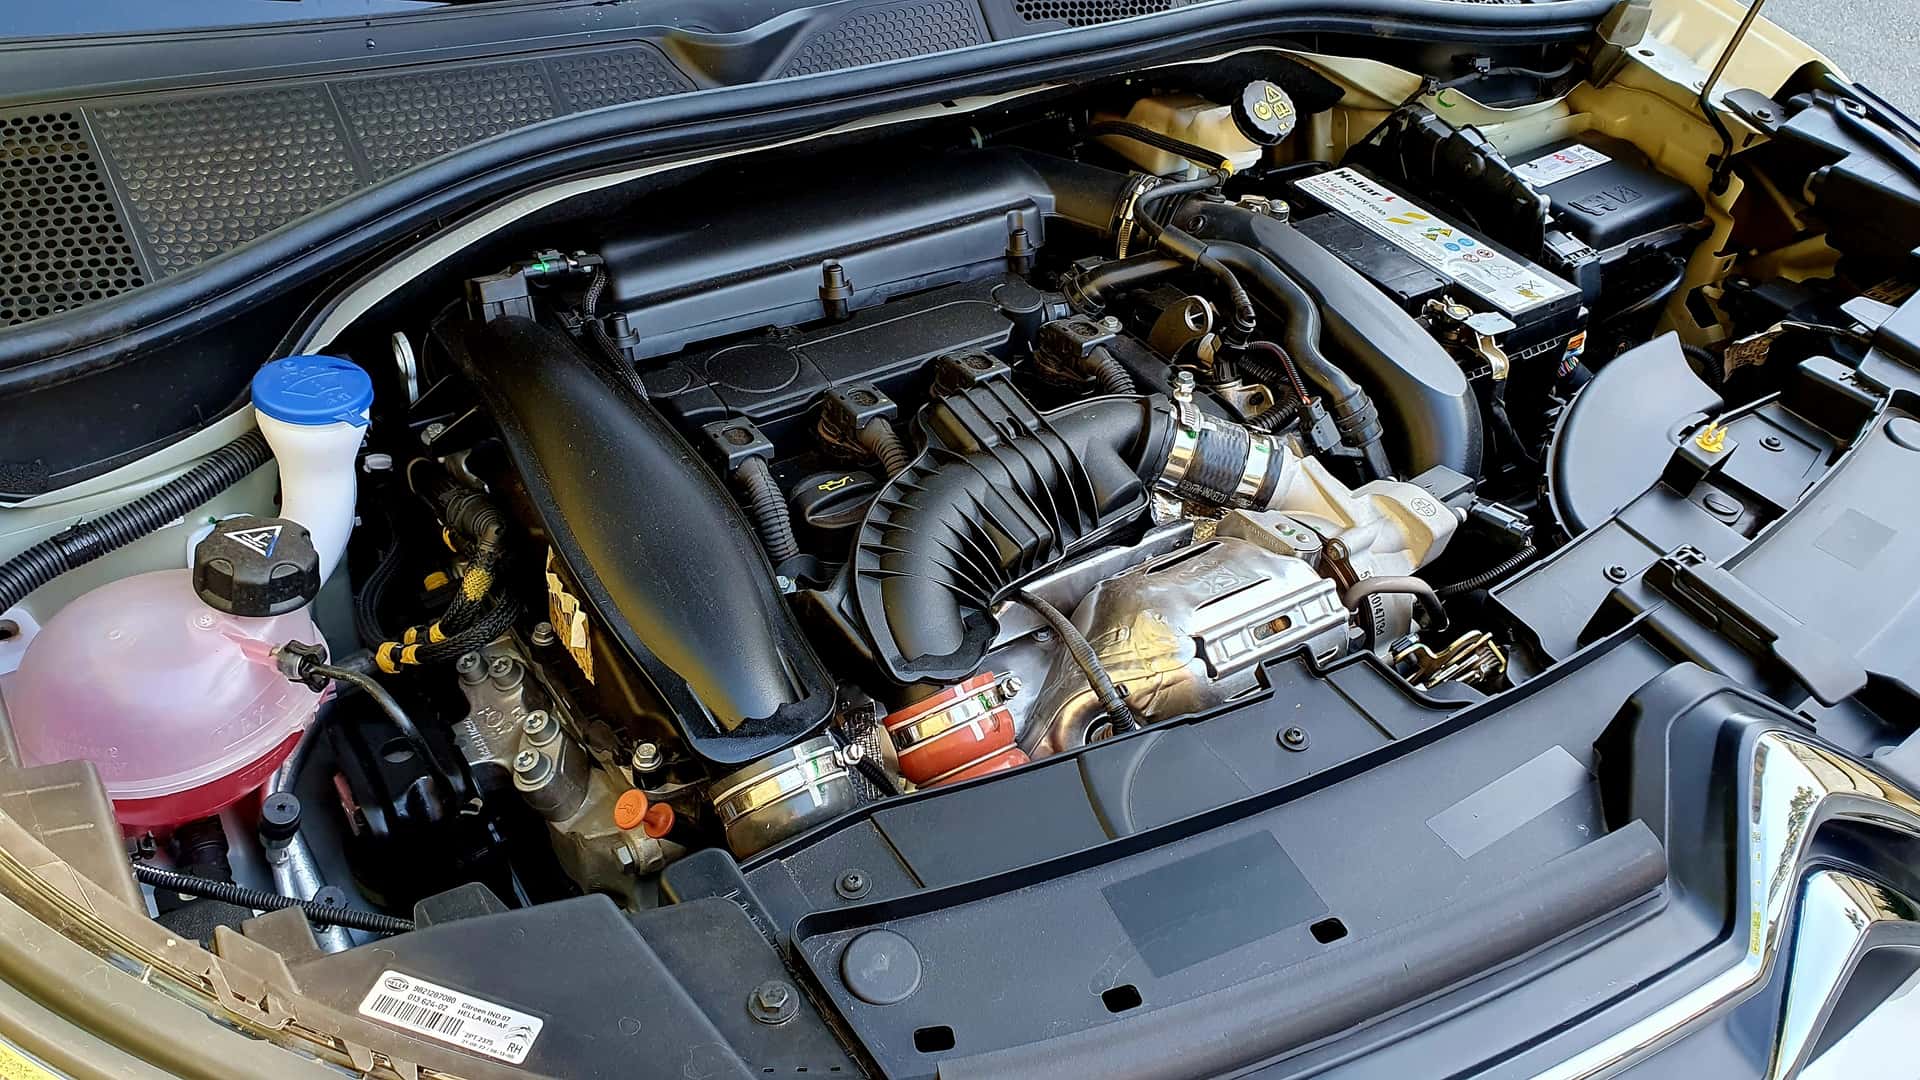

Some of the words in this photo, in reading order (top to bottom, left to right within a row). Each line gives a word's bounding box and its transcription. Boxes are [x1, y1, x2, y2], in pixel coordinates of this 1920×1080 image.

[1333, 170, 1383, 197] Heliar
[457, 1009, 482, 1021] HELLA
[506, 1042, 523, 1055] RH
